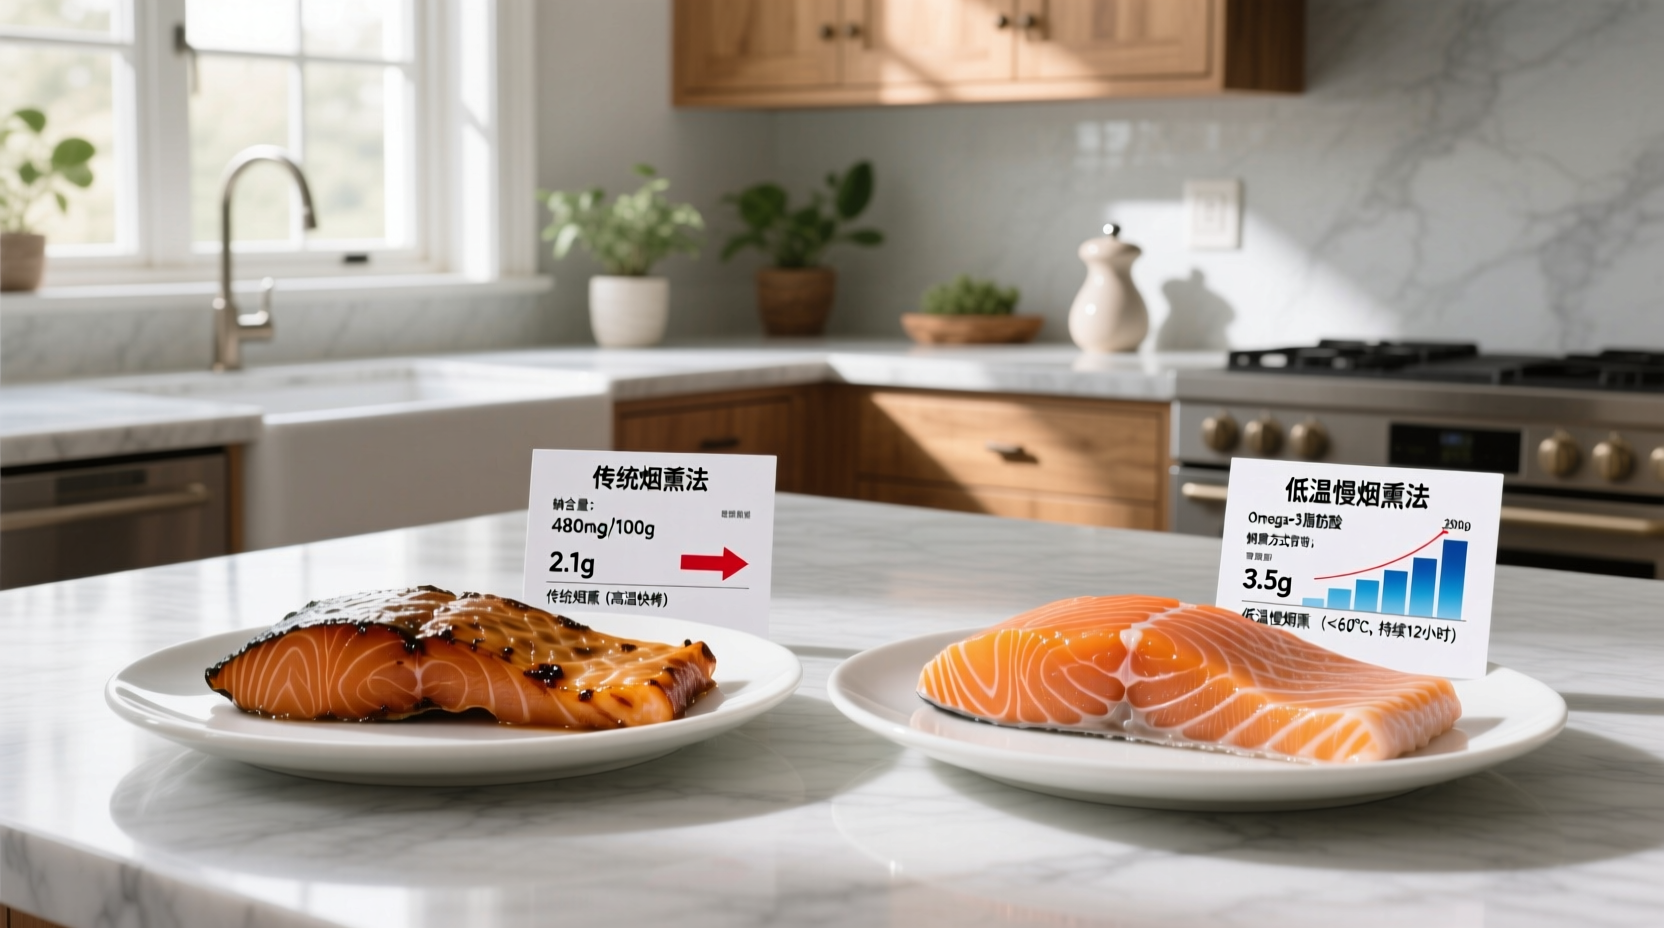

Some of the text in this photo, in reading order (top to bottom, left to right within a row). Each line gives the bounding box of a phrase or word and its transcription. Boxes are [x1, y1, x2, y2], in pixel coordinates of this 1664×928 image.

[593, 465, 709, 492] 传统烟熏法
[1285, 476, 1430, 510] 低温慢烟熏法
[551, 518, 655, 540] 480mg/100g
[549, 551, 595, 579] 2.1g
[1242, 568, 1292, 597] 3.5g
